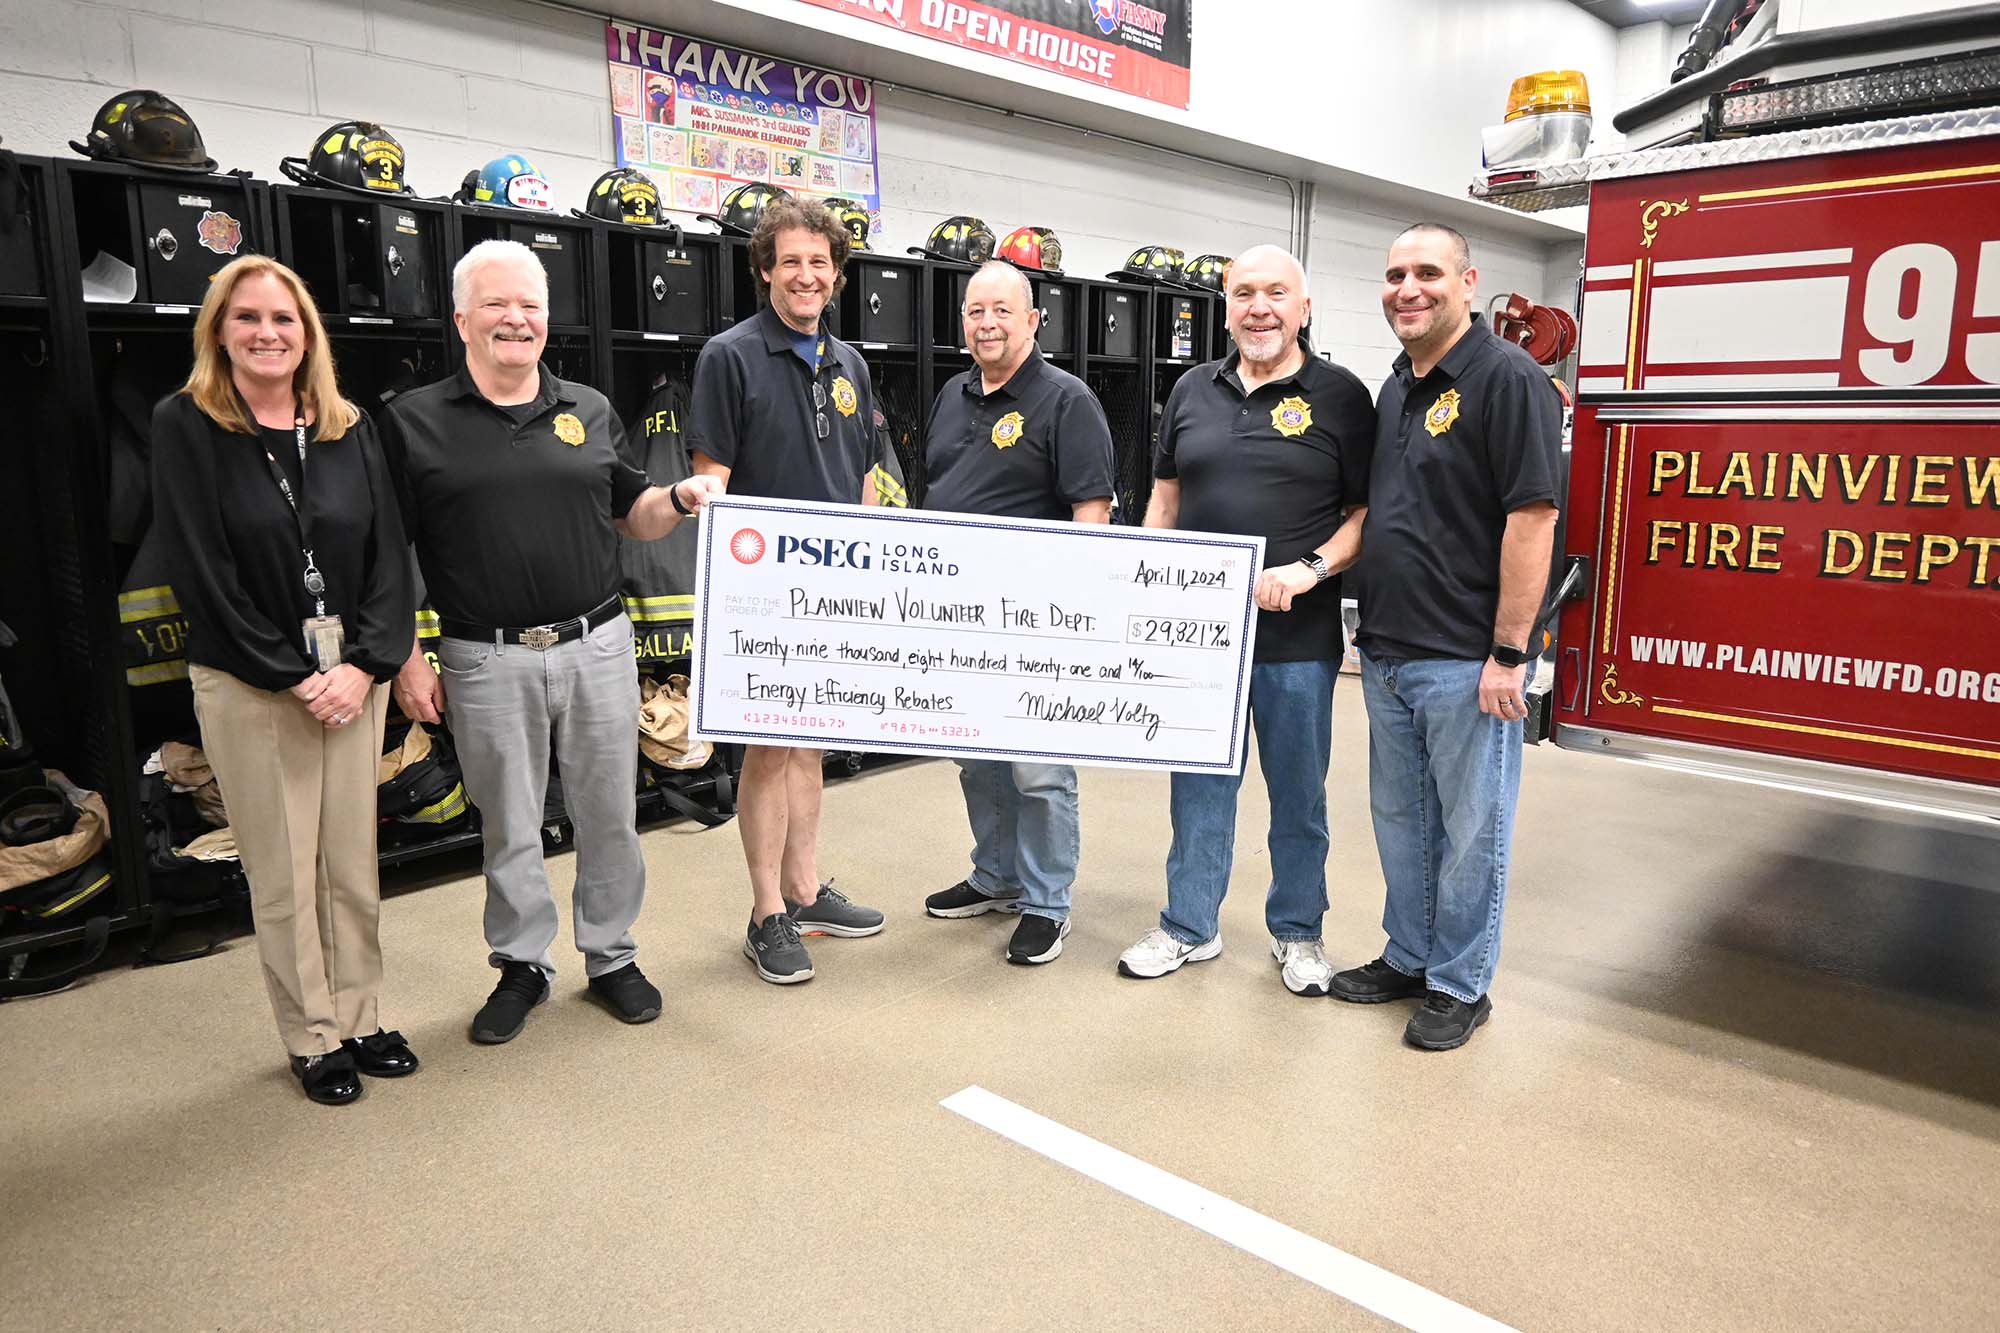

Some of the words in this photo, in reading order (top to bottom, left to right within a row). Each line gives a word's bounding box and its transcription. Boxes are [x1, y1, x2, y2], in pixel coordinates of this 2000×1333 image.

[1119, 0, 1167, 35] FASNY
[920, 0, 1010, 48] OPEN
[1016, 25, 1116, 79] HOUSE
[611, 22, 776, 96] THANK
[792, 66, 872, 113] YOU
[690, 105, 712, 119] MRS.
[715, 109, 760, 127] SUSSMAN'S
[761, 119, 777, 130] 3rd
[778, 122, 811, 137] GRADERS
[692, 120, 710, 131] HHH
[711, 122, 759, 140] PAUMANOK
[760, 132, 808, 148] ELEMENTARY
[380, 158, 393, 180] 3
[634, 197, 647, 216] 3
[853, 223, 862, 240] 3
[1649, 450, 2000, 507] PLAINVIEW
[776, 535, 871, 570] PSEG
[883, 543, 940, 560] LONG
[1646, 520, 1785, 571] FIRE
[881, 559, 959, 577] ISLAND
[1108, 573, 1129, 582] DATE
[1134, 560, 1170, 588] April
[1221, 559, 1236, 568] 001
[724, 604, 757, 616] ORDER
[760, 606, 774, 617] OF
[725, 594, 742, 605] PAY
[747, 596, 760, 606] TO
[763, 598, 781, 608] THE
[789, 587, 886, 620] PLAINVIEW
[895, 587, 986, 627] VOLUNTEER
[1001, 597, 1041, 629] FIRE
[1049, 602, 1097, 632] DEPT.
[950, 648, 1007, 672] hundred
[1099, 661, 1121, 680] and
[1629, 635, 2000, 703] WWW.PLAINVIEWFD.ORG
[720, 688, 740, 698] FOR
[746, 673, 807, 712] Energy
[814, 678, 886, 716] Efficiency
[894, 686, 954, 711] Rebates
[1018, 690, 1106, 724] Michael
